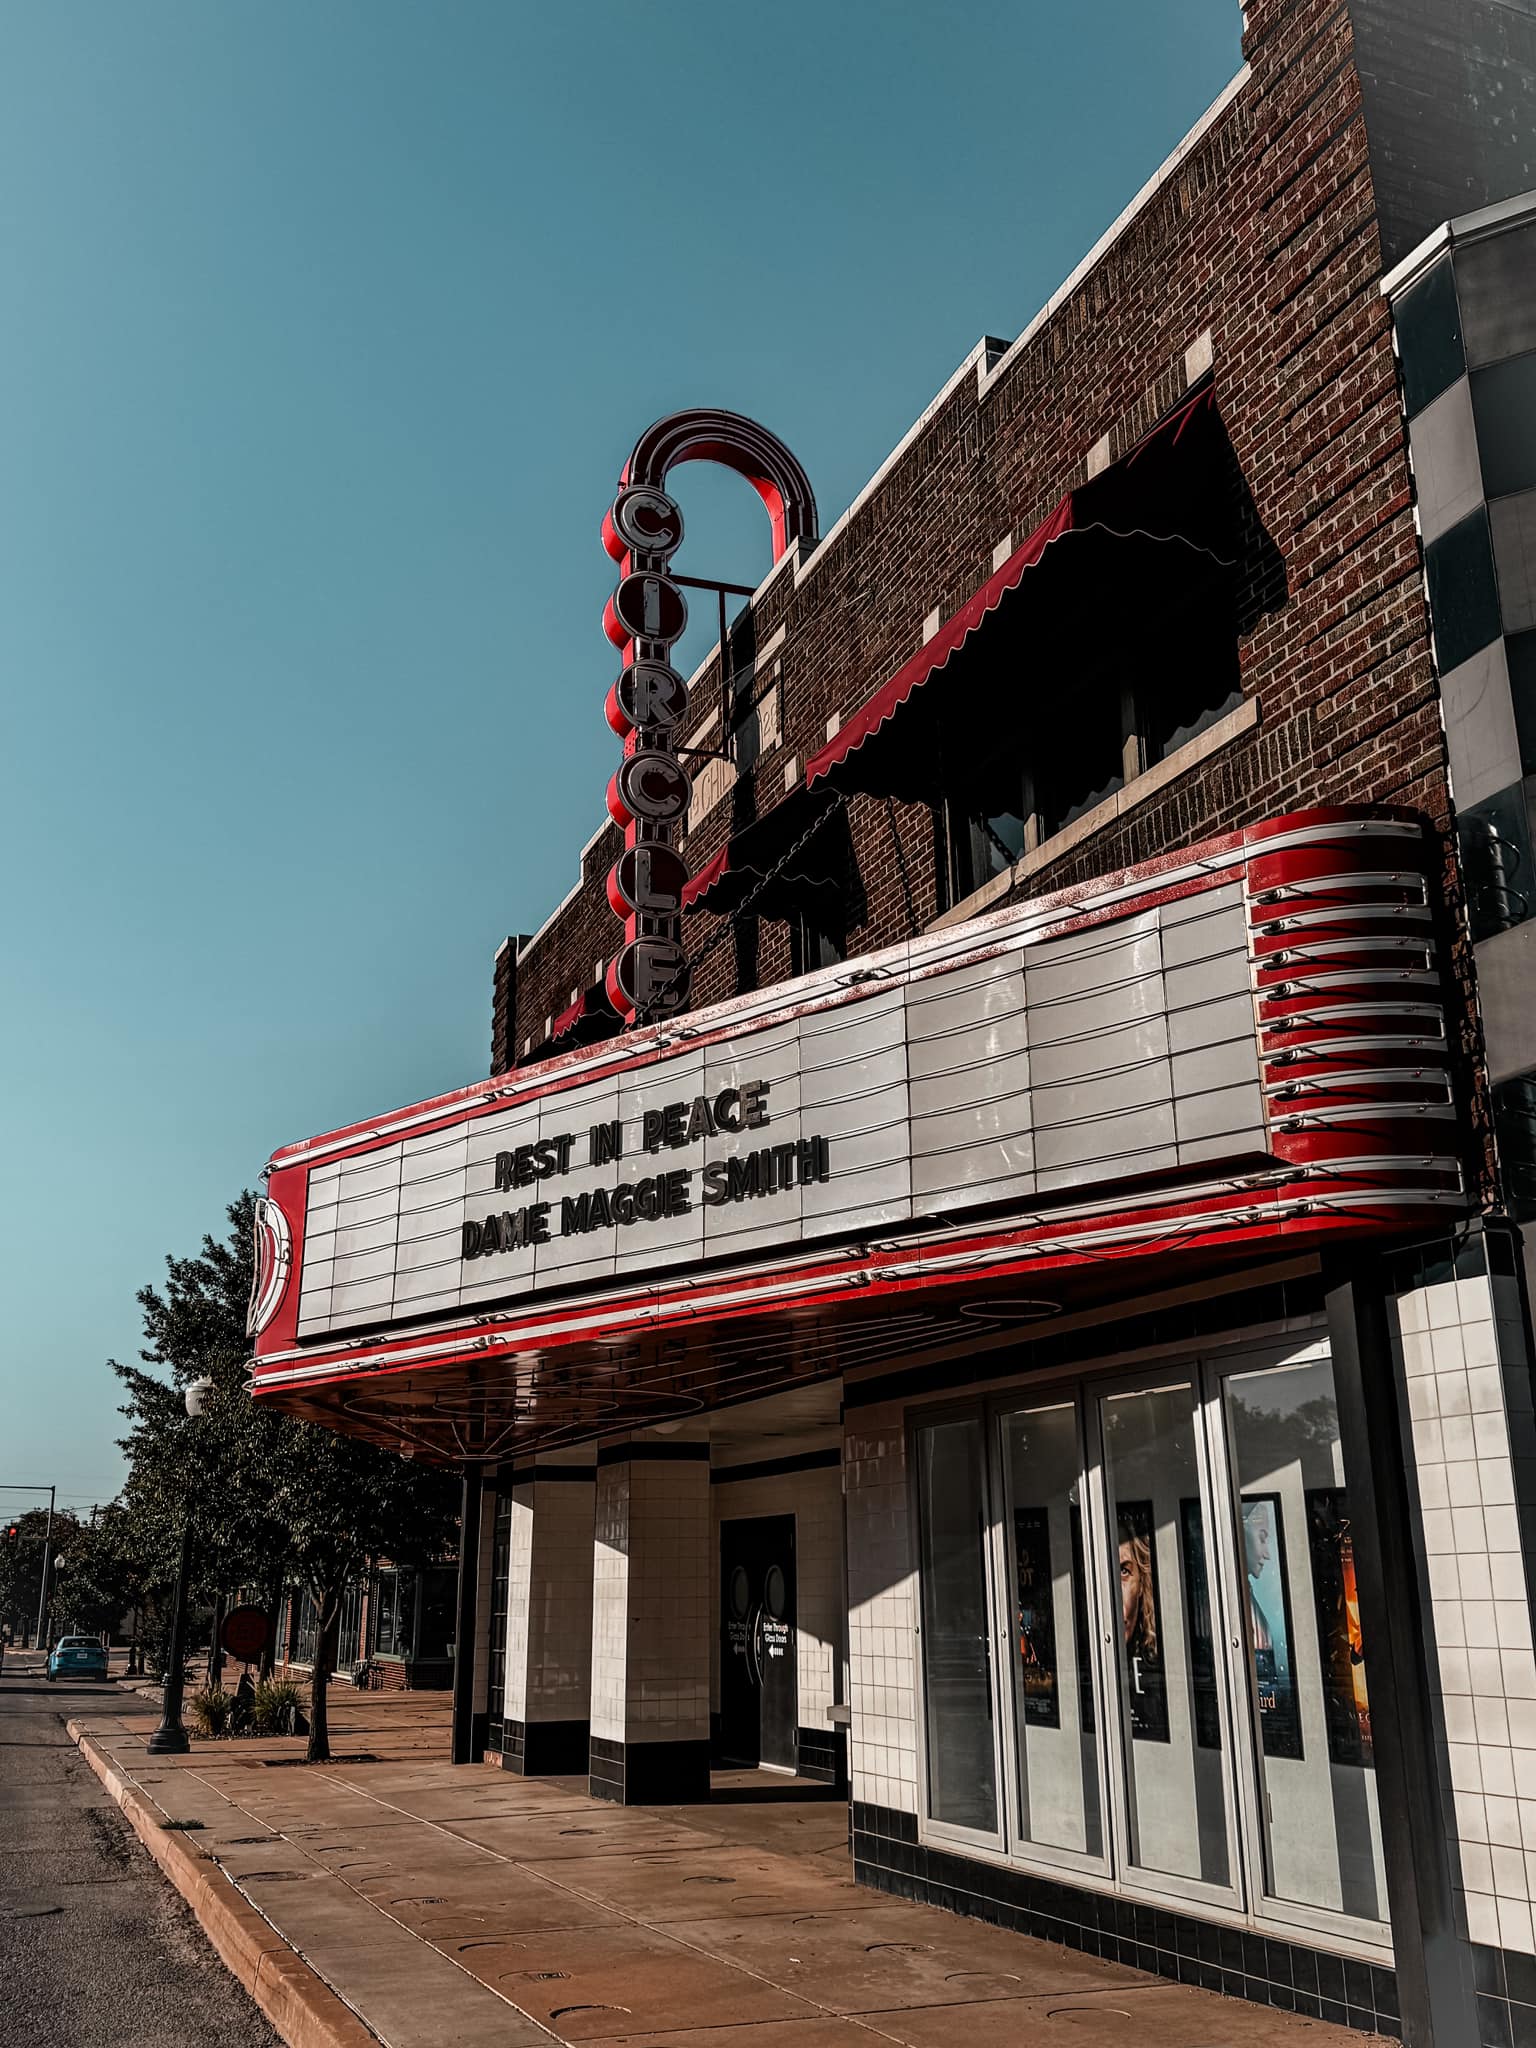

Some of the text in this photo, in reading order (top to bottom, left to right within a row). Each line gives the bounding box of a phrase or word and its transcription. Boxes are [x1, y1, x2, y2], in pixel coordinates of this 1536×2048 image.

[619, 487, 681, 1004] CIRCLE
[462, 1135, 829, 1259] DAME MAGGIE SMITH
[495, 1080, 769, 1191] REST IN PEACE
